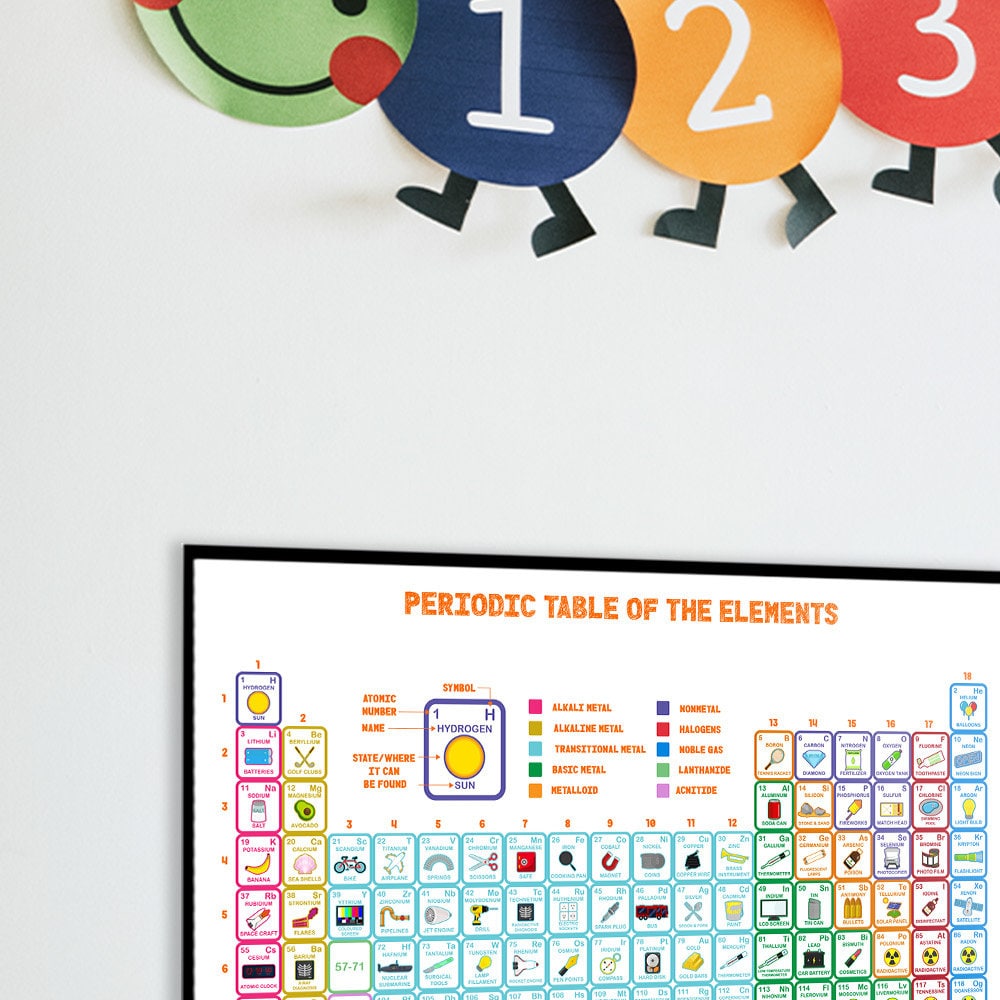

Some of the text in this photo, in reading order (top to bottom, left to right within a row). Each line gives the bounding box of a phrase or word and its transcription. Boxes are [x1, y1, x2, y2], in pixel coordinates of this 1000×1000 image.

[898, 0, 978, 98] 3
[466, 0, 554, 134] 1
[666, 0, 773, 132] 2
[405, 591, 838, 625] PERIODIC TABLE OF THE ELEMENTS
[256, 660, 260, 669] 1
[963, 672, 972, 680] 18
[443, 683, 476, 692] SYMBOL
[973, 687, 983, 695] He
[222, 694, 226, 703] 1
[363, 694, 396, 703] ATOMIC
[362, 707, 396, 716] NUMBER
[552, 703, 612, 712] ALKALI METAL
[680, 705, 720, 713] NONMETAL
[300, 714, 306, 722] 2
[433, 708, 495, 721] 1 H
[769, 719, 778, 727] 13
[809, 719, 818, 727] 14
[886, 720, 895, 728] 16
[925, 720, 933, 728] 17
[362, 724, 384, 732] NAME
[437, 724, 493, 734] HYDROGEN
[554, 724, 624, 733] ALKALINE METAL
[680, 725, 721, 733] HALOGENS
[222, 748, 228, 757] 2
[555, 745, 646, 753] TRANSITIONAL METAL
[679, 746, 723, 754] NOBLE GAS
[353, 754, 415, 762] STATE/WHERE
[369, 767, 400, 775] IT CAN
[552, 765, 606, 774] BASIC METAL
[679, 766, 730, 774] LANTHANIDE
[364, 780, 406, 788] BE FOUND
[455, 781, 476, 790] SUN
[551, 786, 598, 794] METALLOID
[676, 786, 717, 794] ACNITIDE
[222, 802, 228, 811] 3
[346, 820, 352, 829] 3
[391, 820, 397, 828] 4
[436, 820, 441, 828] 5
[479, 820, 485, 828] 6
[523, 819, 528, 828] 7
[565, 819, 570, 828] 8
[608, 819, 613, 827] 9
[646, 819, 656, 827] 10
[687, 819, 695, 827] 11
[728, 818, 737, 827] 12
[270, 838, 277, 846] K
[531, 836, 543, 844] Mn
[222, 856, 228, 864] 4
[222, 910, 227, 919] 5
[265, 946, 276, 954] Cs
[222, 964, 228, 973] 6
[335, 962, 364, 972] 57-71
[972, 980, 983, 988] Og
